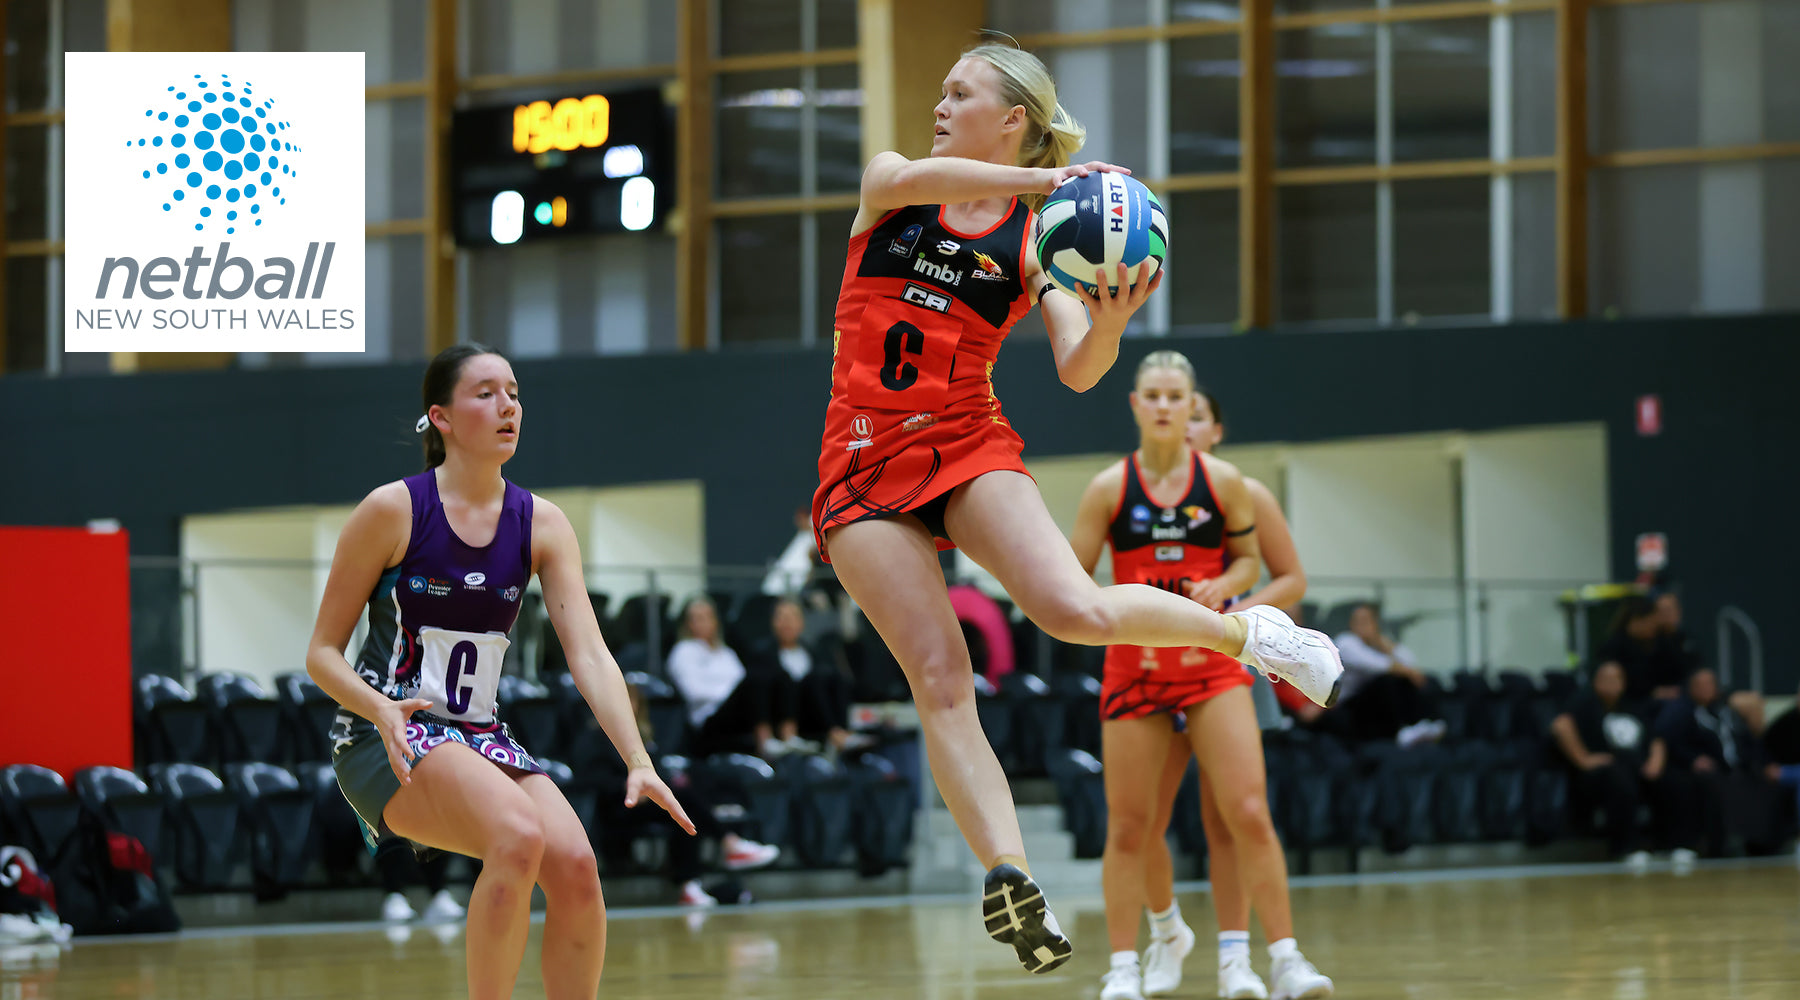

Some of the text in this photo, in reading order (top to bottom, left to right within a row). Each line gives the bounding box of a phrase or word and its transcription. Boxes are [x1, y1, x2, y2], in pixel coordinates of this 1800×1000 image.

[1110, 182, 1123, 232] HART
[913, 252, 955, 283] imb
[880, 321, 924, 391] C
[446, 640, 478, 715] C
